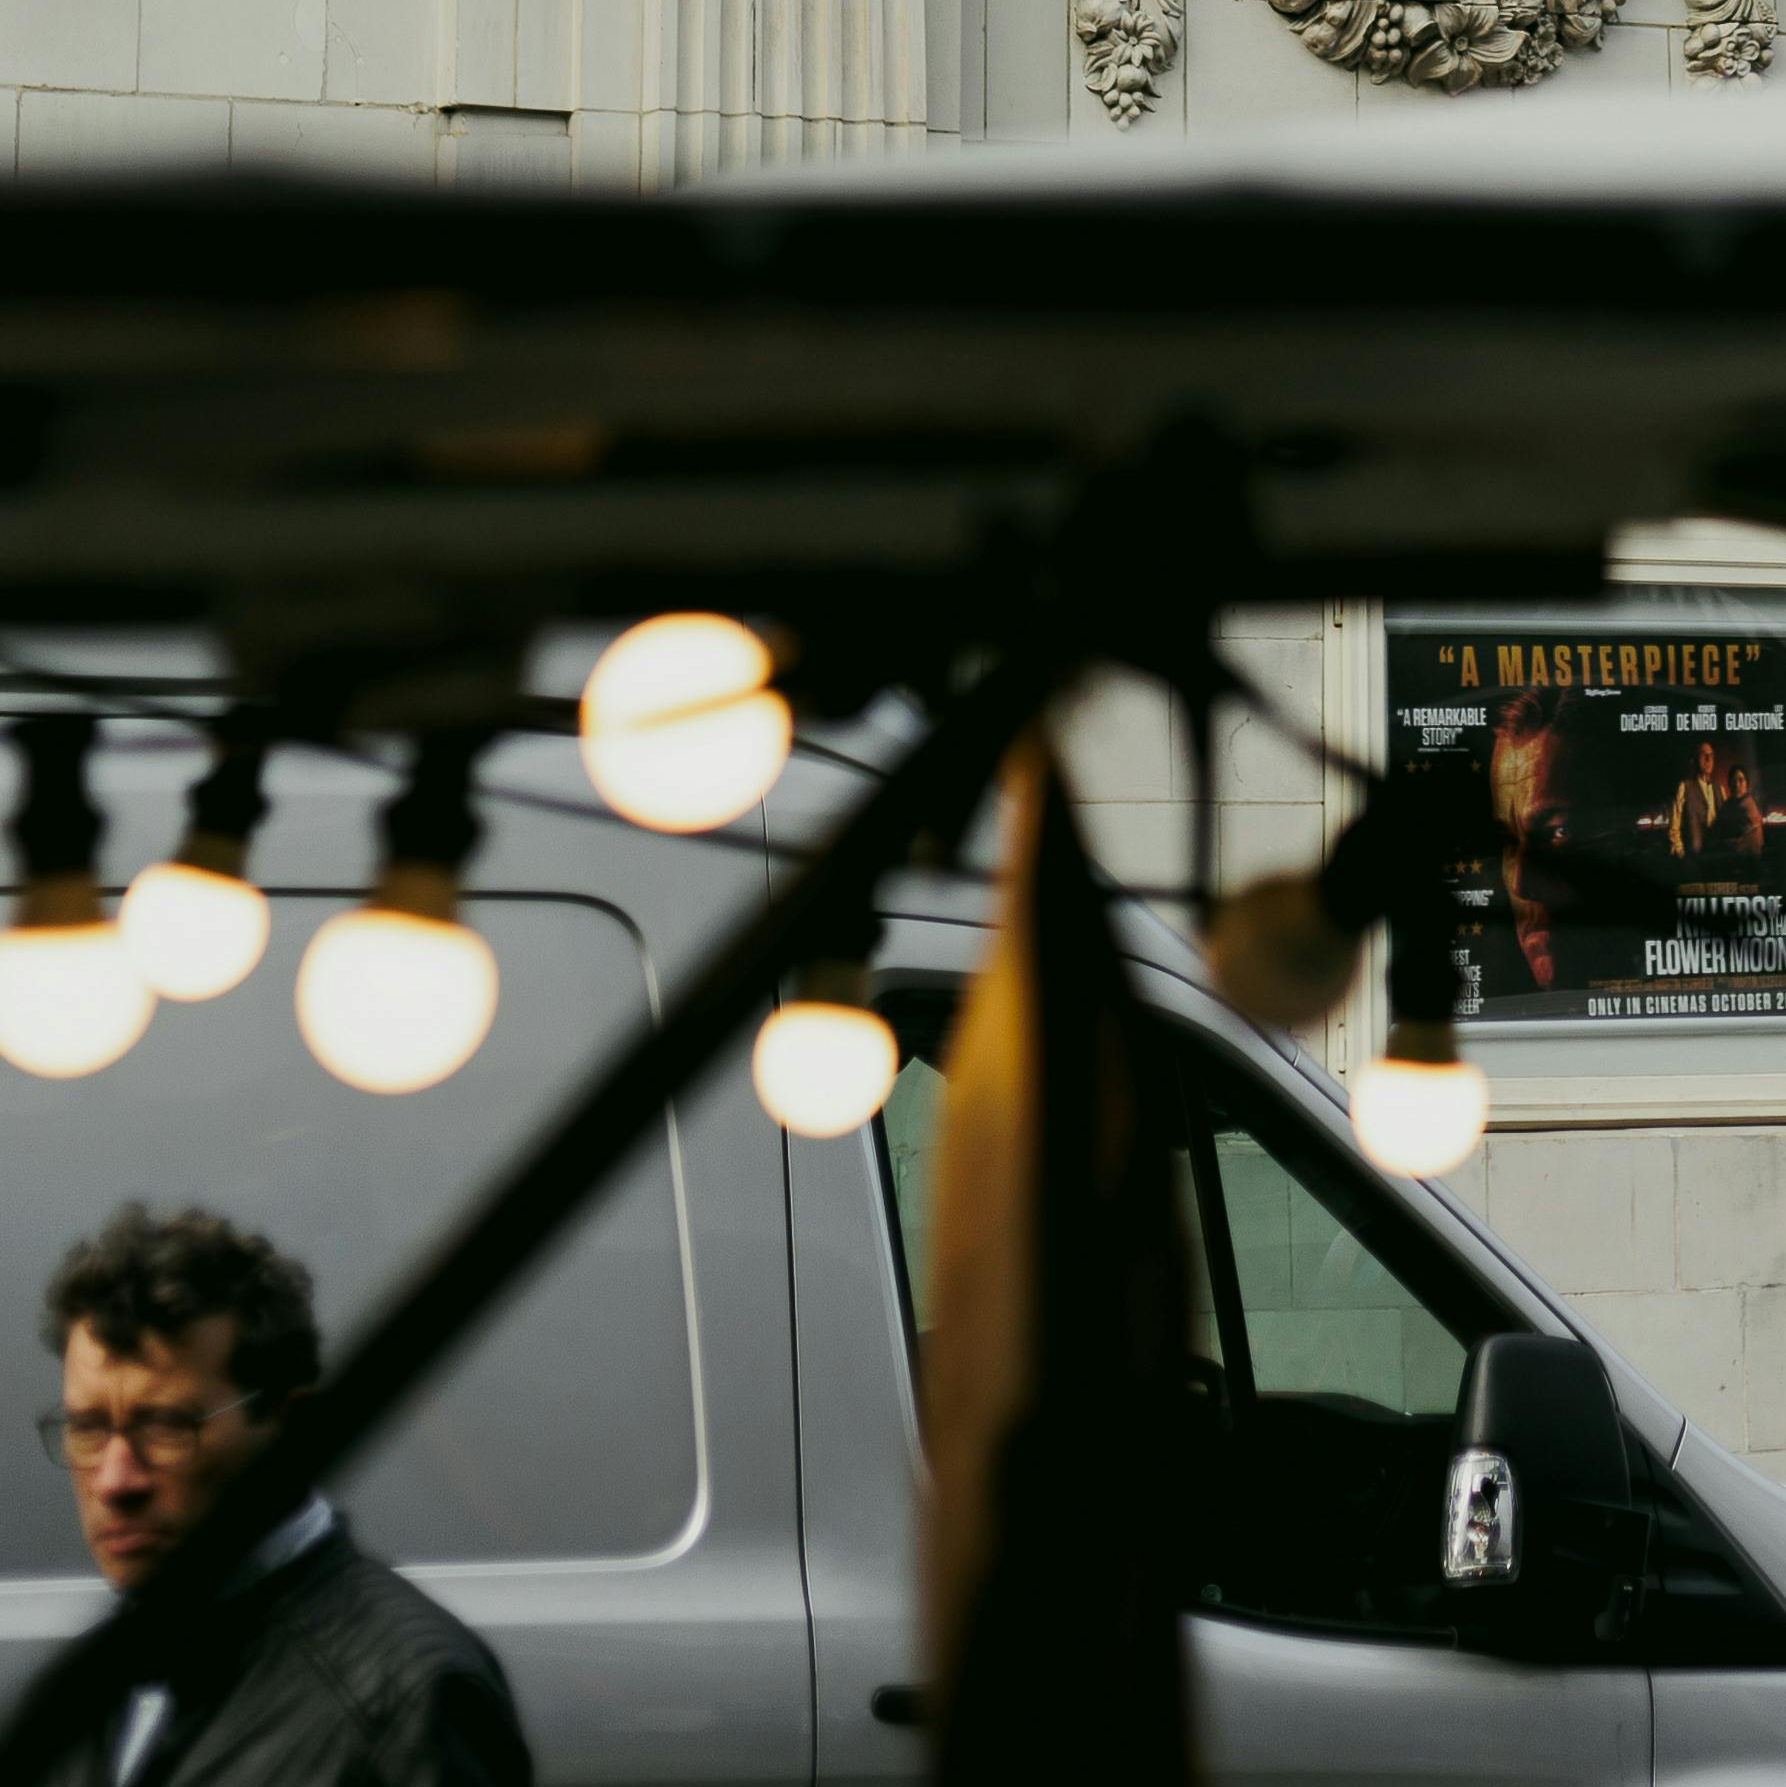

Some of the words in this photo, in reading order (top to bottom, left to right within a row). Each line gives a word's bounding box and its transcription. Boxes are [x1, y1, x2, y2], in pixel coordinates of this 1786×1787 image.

[1413, 707, 1487, 727] REMARKABLE
[1676, 713, 1690, 731] DE
[1692, 713, 1717, 731] NIRO
[1725, 712, 1785, 730] GLADSTONE
[1645, 937, 1726, 975] FLOWER
[1588, 997, 1621, 1017] ONLY
[1626, 996, 1641, 1015] IN
[1646, 995, 1707, 1014] CINEMAS
[1711, 993, 1772, 1012] OCTOBER
